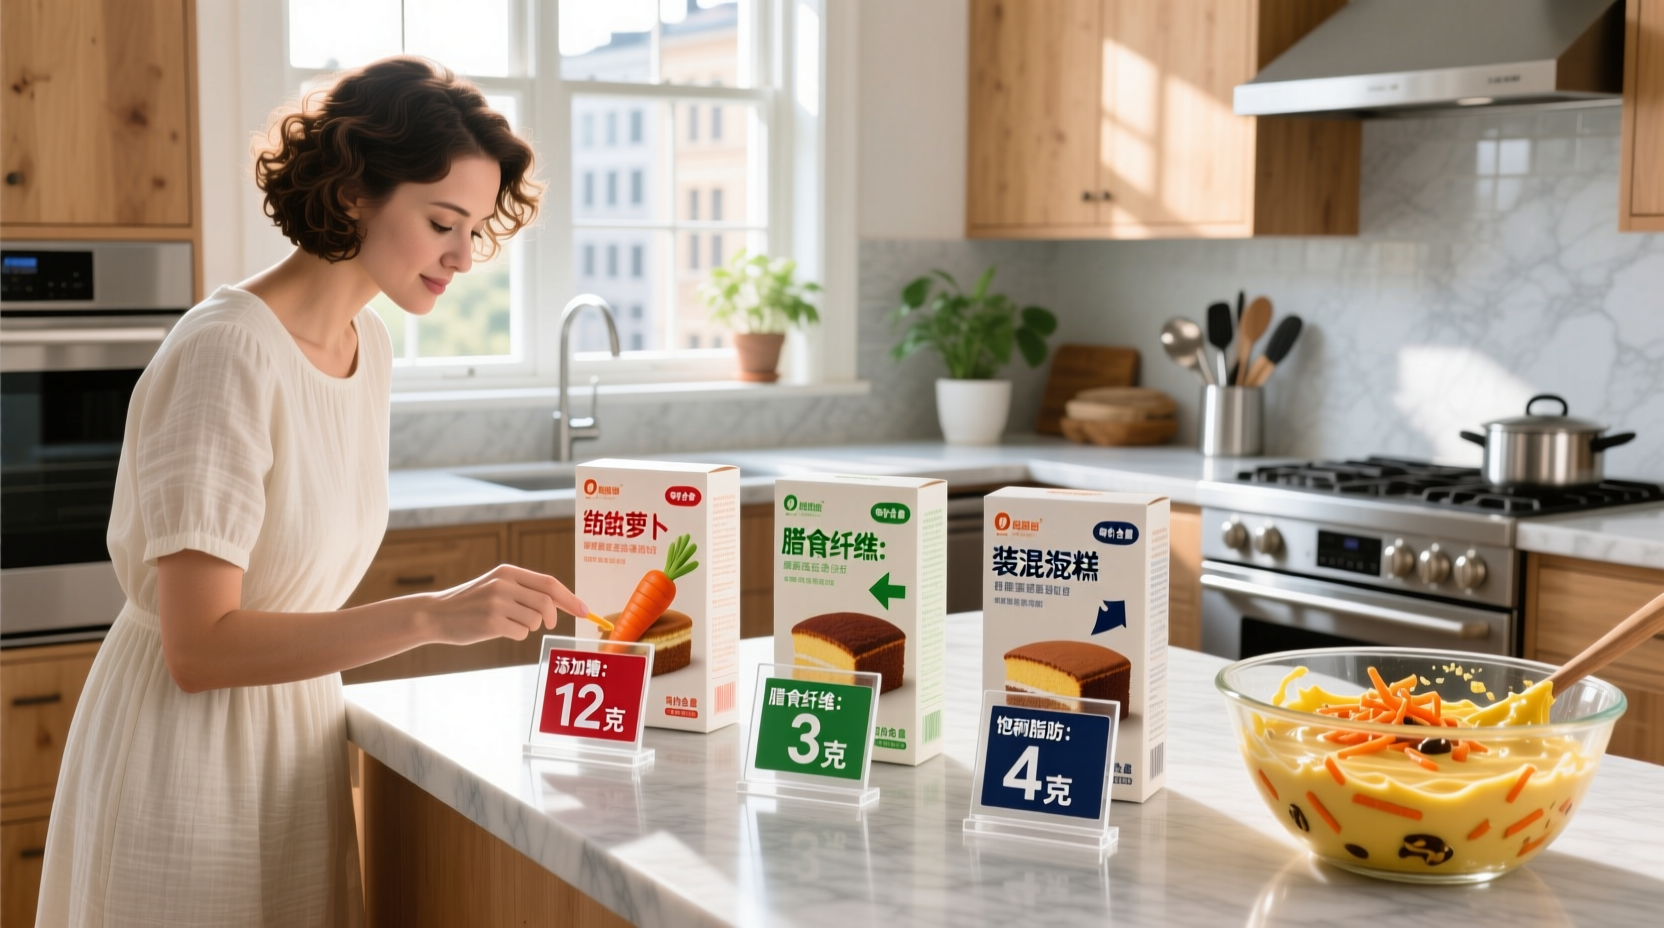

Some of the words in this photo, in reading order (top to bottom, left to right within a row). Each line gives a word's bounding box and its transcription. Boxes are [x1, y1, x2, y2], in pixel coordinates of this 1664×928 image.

[555, 682, 626, 733] 12克
[787, 712, 848, 770] 3克
[1002, 744, 1073, 807] 4克
